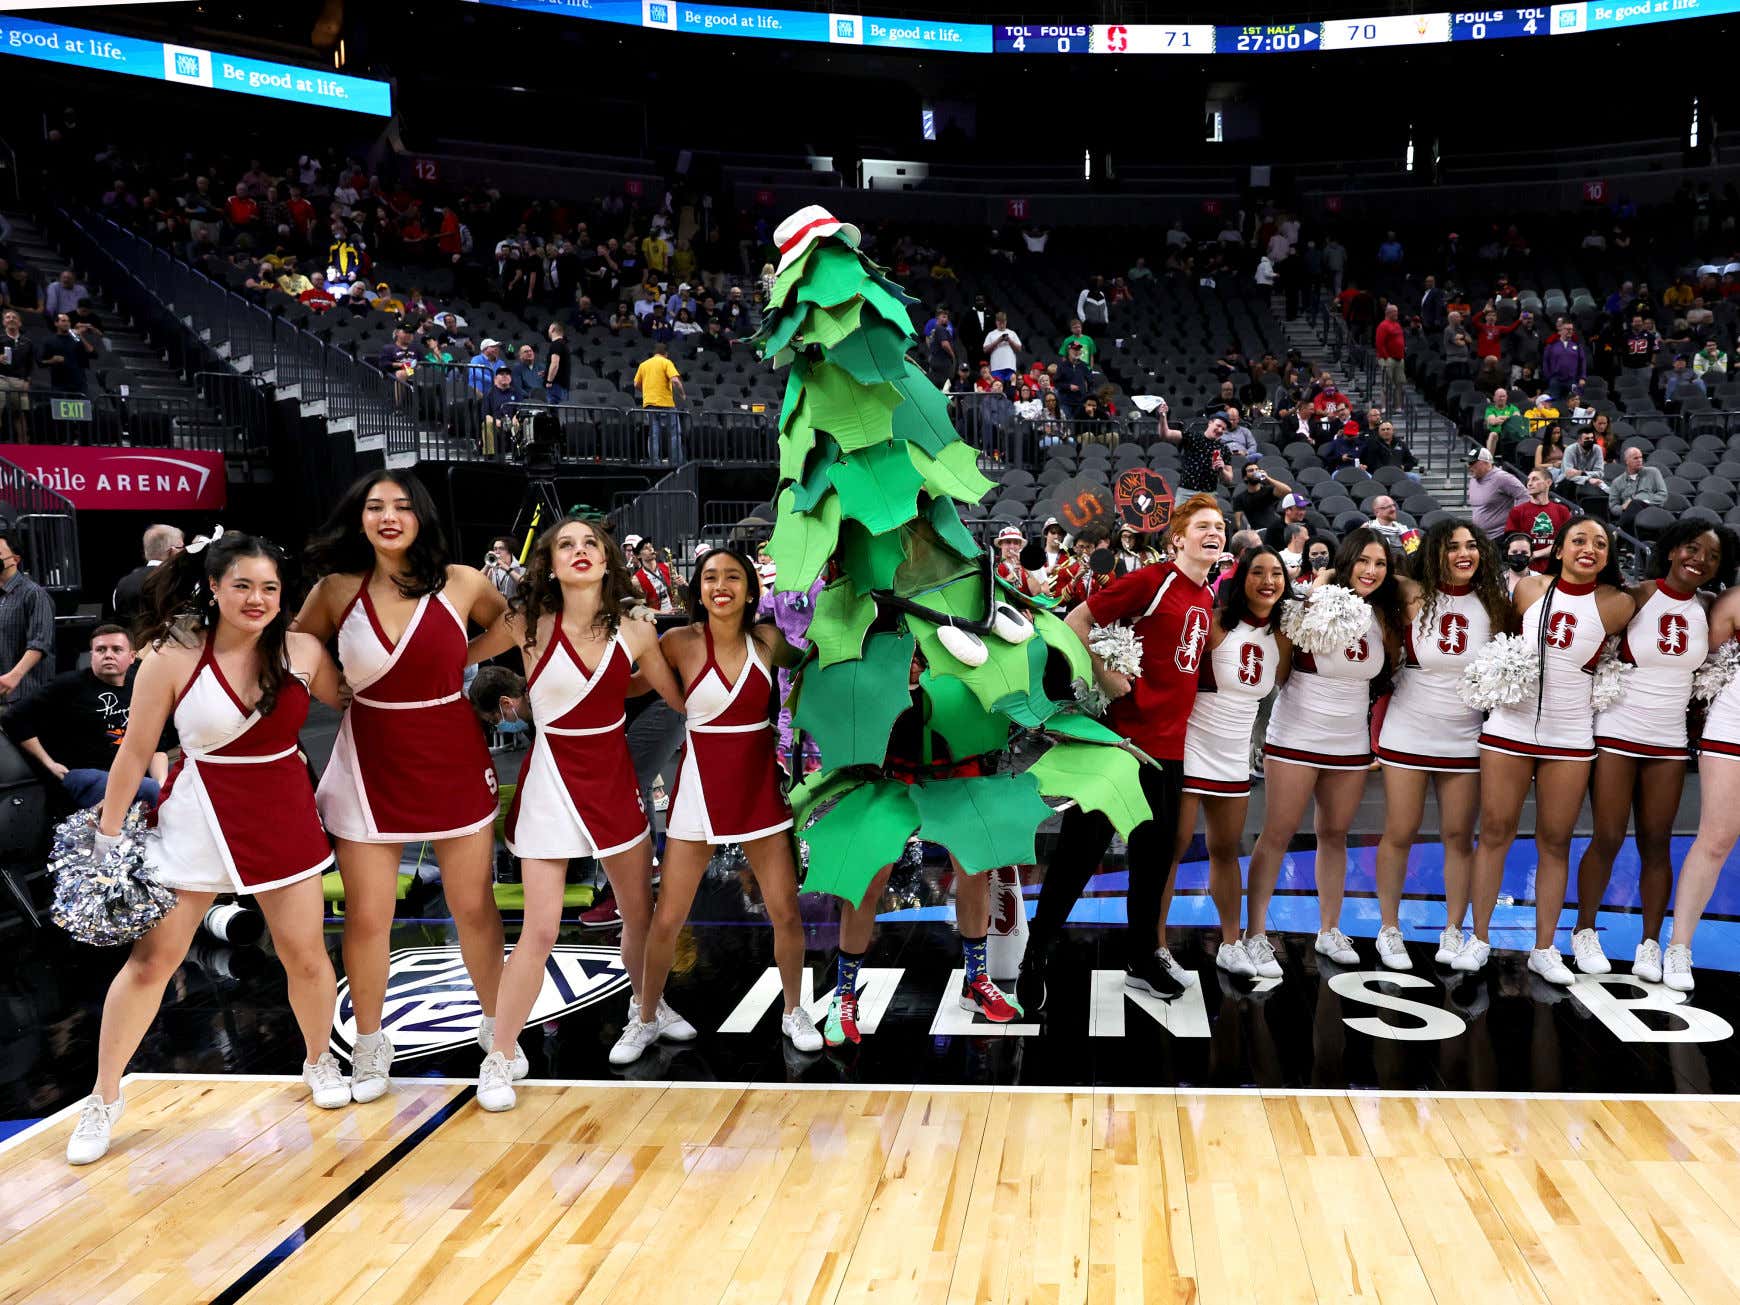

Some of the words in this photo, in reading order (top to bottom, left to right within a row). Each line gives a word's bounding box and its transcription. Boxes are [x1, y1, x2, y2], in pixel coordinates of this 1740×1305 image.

[685, 10, 701, 24] Be
[704, 13, 738, 28] good
[741, 16, 754, 27] at
[757, 15, 782, 29] life.
[1455, 10, 1504, 24] FOULS
[1516, 8, 1545, 20] TOL
[1595, 8, 1613, 20] Be
[1615, 1, 1651, 21] good
[1655, 1, 1670, 12] at
[870, 24, 886, 36] Be
[889, 26, 920, 41] good
[923, 30, 936, 40] at
[939, 28, 963, 42] life.
[1005, 26, 1032, 37] TOL
[1040, 26, 1086, 36] FOULS
[1242, 27, 1262, 35] 1ST
[1267, 25, 1296, 35] HALF
[1347, 25, 1376, 41] 70
[1472, 23, 1486, 39] 0
[1523, 19, 1538, 34] 4
[9, 29, 59, 49] good
[65, 39, 84, 54] at
[90, 39, 127, 61] life.
[1012, 36, 1026, 52] 4
[1057, 37, 1070, 53] 0
[1165, 31, 1192, 47] 71
[1237, 34, 1300, 51] 27:00
[223, 63, 245, 80] Be
[249, 72, 292, 88] good
[296, 79, 313, 92] at
[317, 79, 349, 99] life.
[416, 161, 436, 180] 12
[1589, 182, 1602, 200] 10
[61, 401, 84, 418] EXIT
[96, 474, 191, 492] ARENA
[484, 767, 498, 795] S
